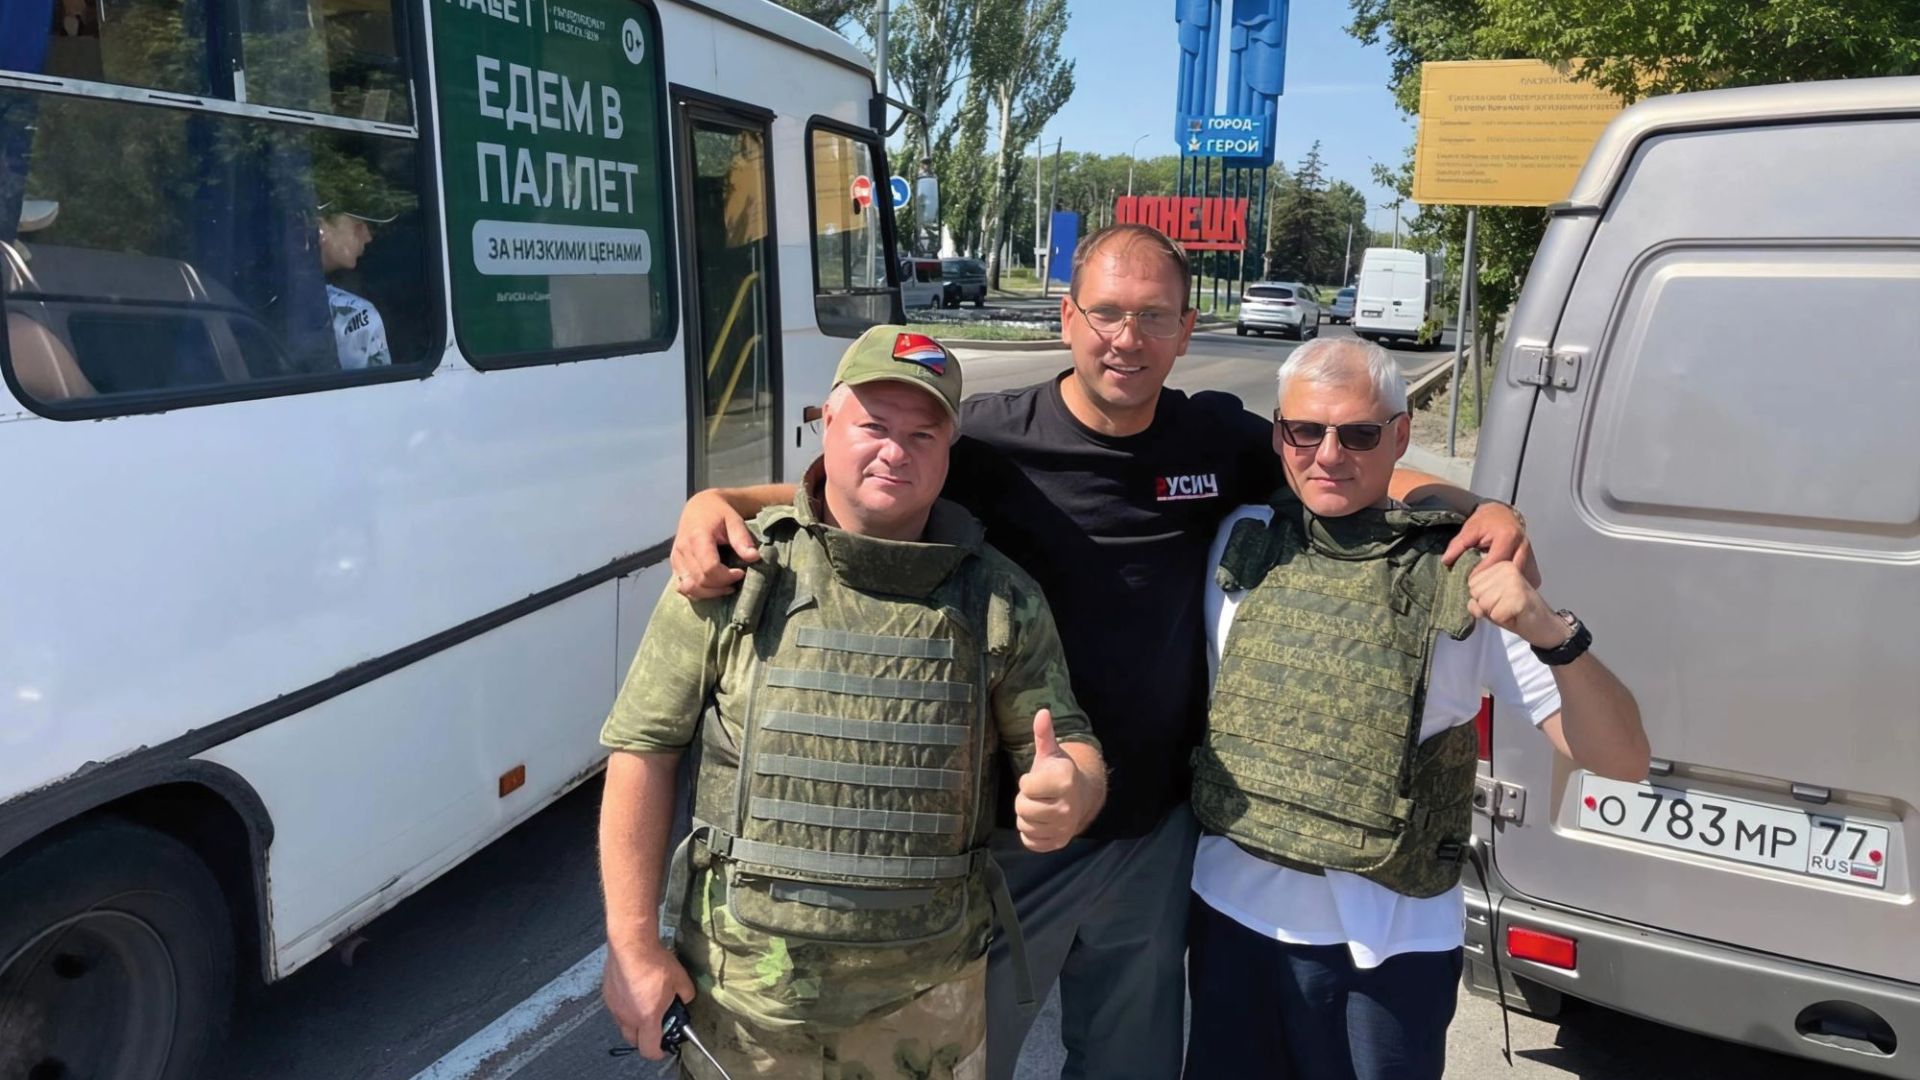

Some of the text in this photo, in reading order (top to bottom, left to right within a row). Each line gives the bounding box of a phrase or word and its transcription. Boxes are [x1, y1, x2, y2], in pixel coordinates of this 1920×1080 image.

[625, 30, 643, 52] 0+
[476, 54, 624, 139] ЕДЕМ В
[1208, 118, 1260, 131] ГОРОД-
[1207, 136, 1259, 152] ГЕРОЙ
[476, 141, 638, 214] ПАЛЛЕТ
[488, 237, 642, 264] ЗА НИЗКИМИ ЦЕНАМИ
[1818, 821, 1869, 861] 77
[1811, 854, 1849, 874] RUS
